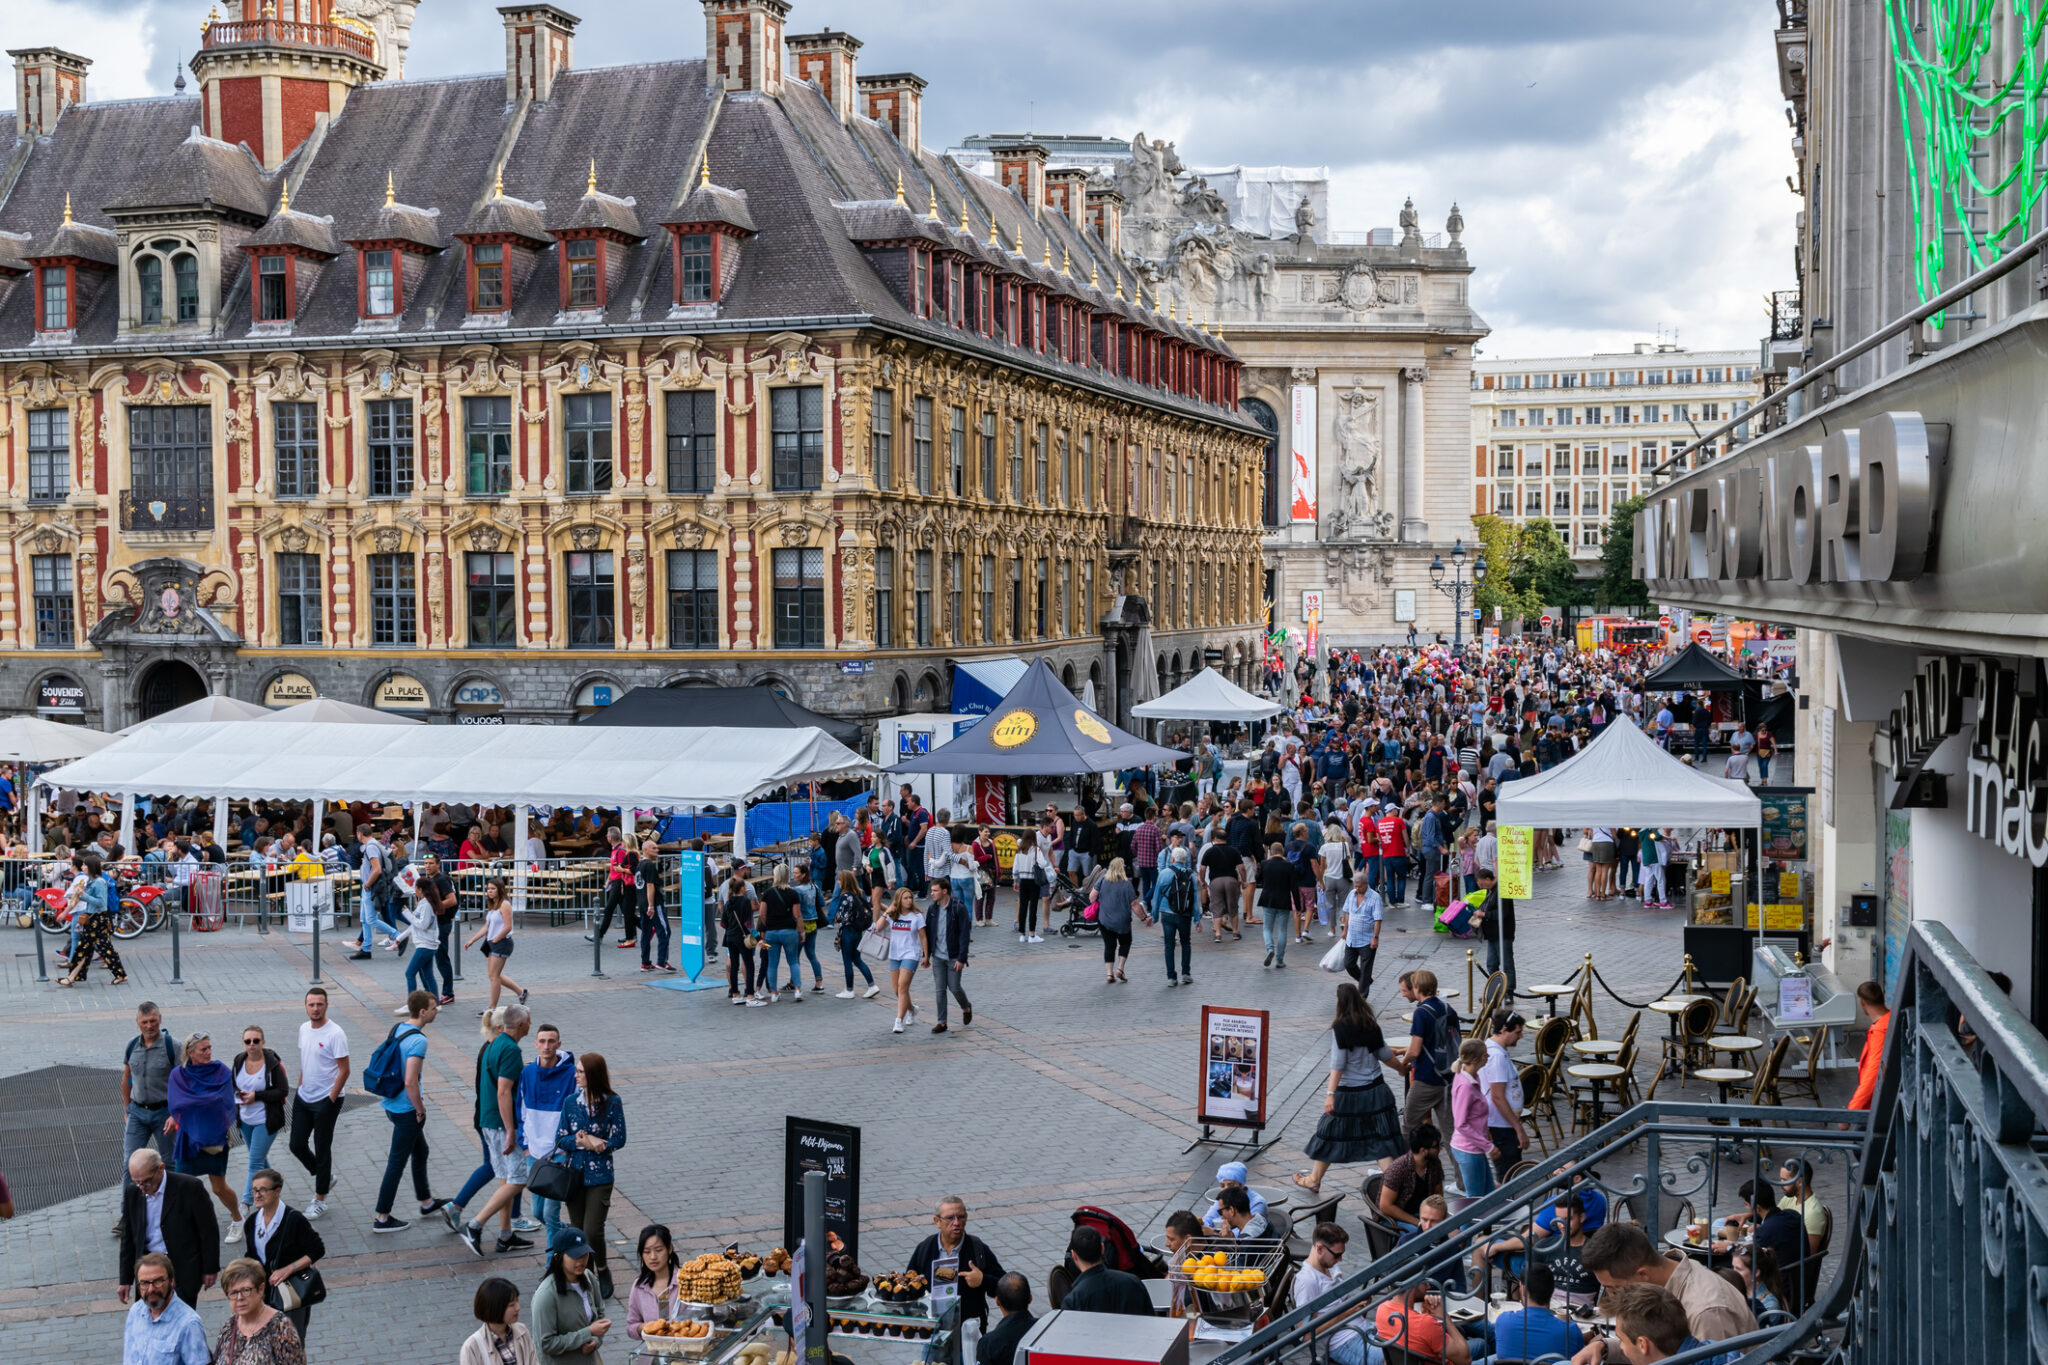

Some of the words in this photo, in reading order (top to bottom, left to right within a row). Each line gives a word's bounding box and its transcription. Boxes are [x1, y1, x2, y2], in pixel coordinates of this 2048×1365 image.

[1762, 410, 1930, 586] NORD
[1307, 595, 1318, 604] 19
[1772, 643, 1796, 652] free
[1683, 681, 1702, 689] PAUL
[42, 687, 84, 697] SOUVENIRS
[273, 686, 284, 694] LA
[287, 686, 312, 694] PLACE
[384, 687, 394, 695] LA
[398, 687, 423, 696] PLACE
[58, 698, 77, 706] Lille
[1548, 1257, 1588, 1278] COFFEE
